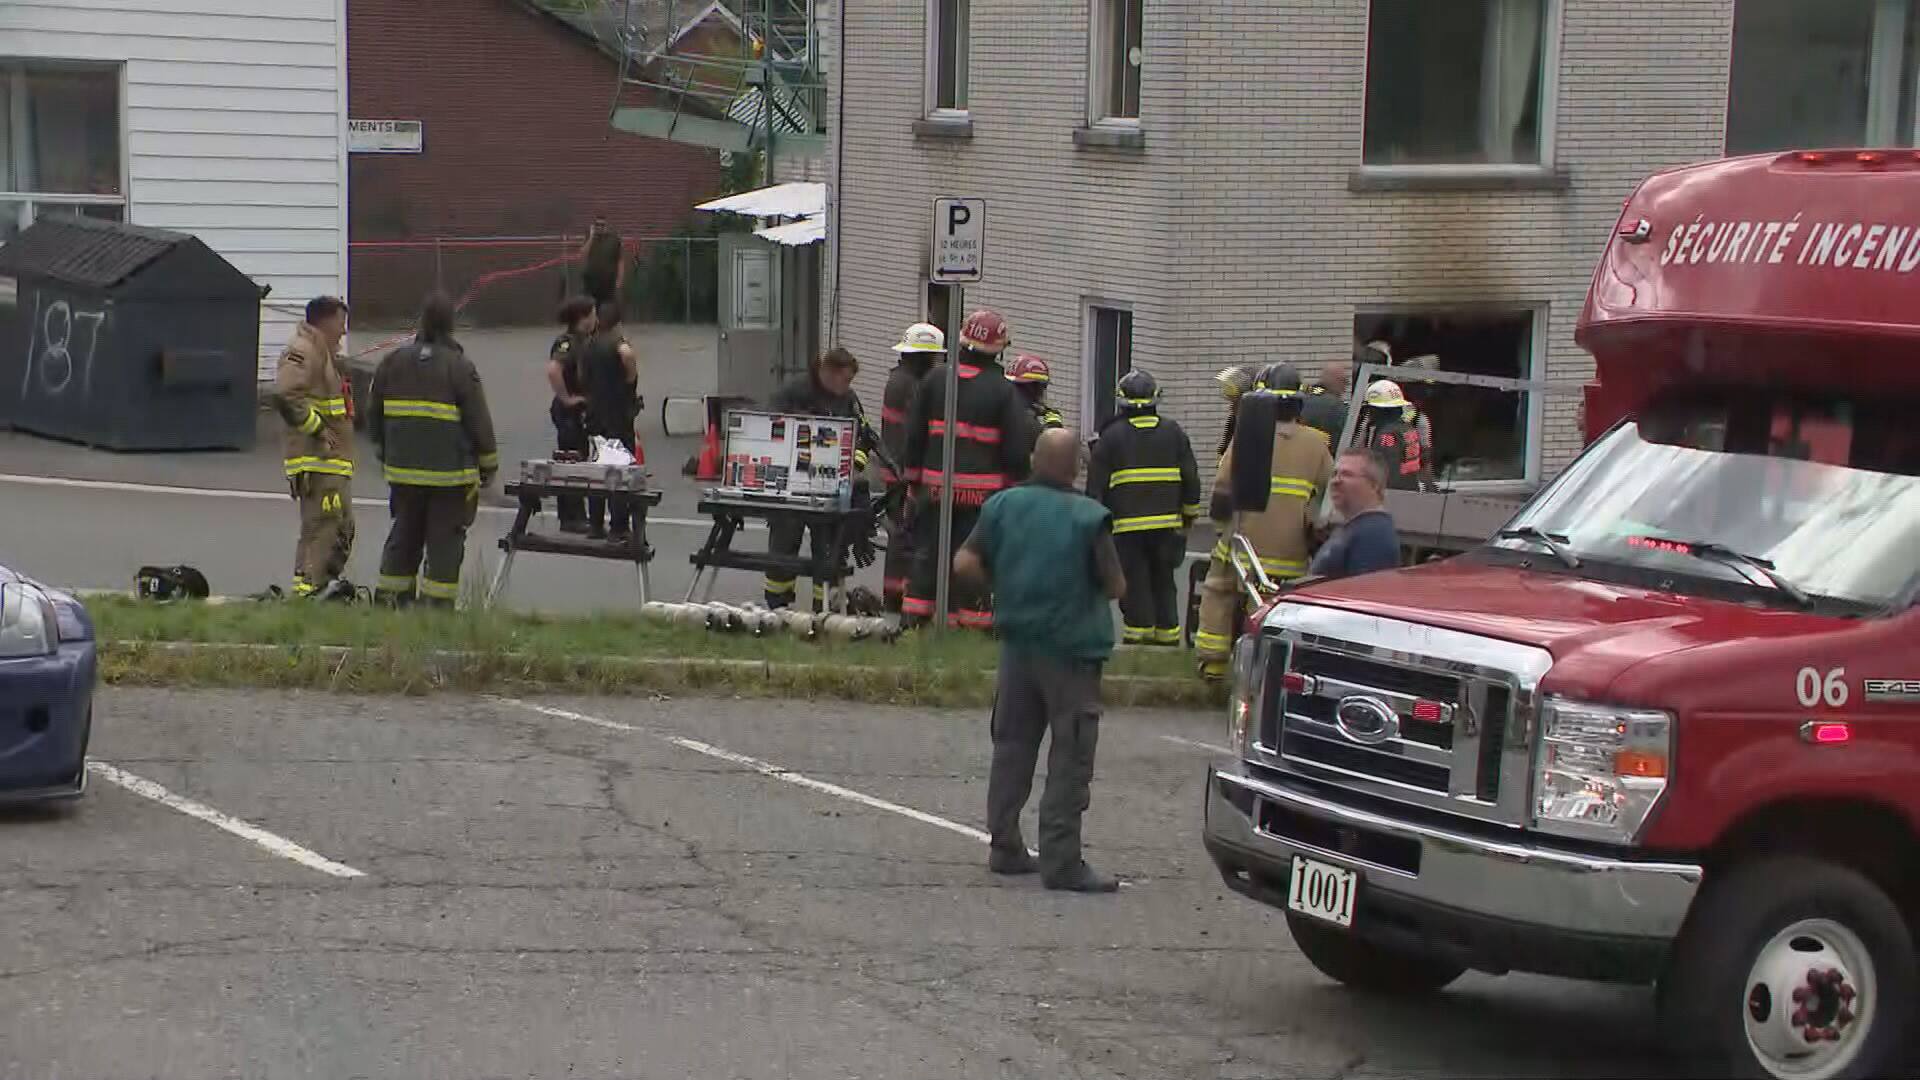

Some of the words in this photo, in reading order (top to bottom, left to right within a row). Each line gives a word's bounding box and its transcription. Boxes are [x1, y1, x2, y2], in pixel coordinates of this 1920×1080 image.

[948, 205, 970, 236] P
[1660, 211, 1803, 267] SÉCURITÉ
[22, 288, 105, 402] 187
[969, 322, 989, 340] 103
[1796, 666, 1849, 708] 06
[1296, 865, 1351, 919] 1001
